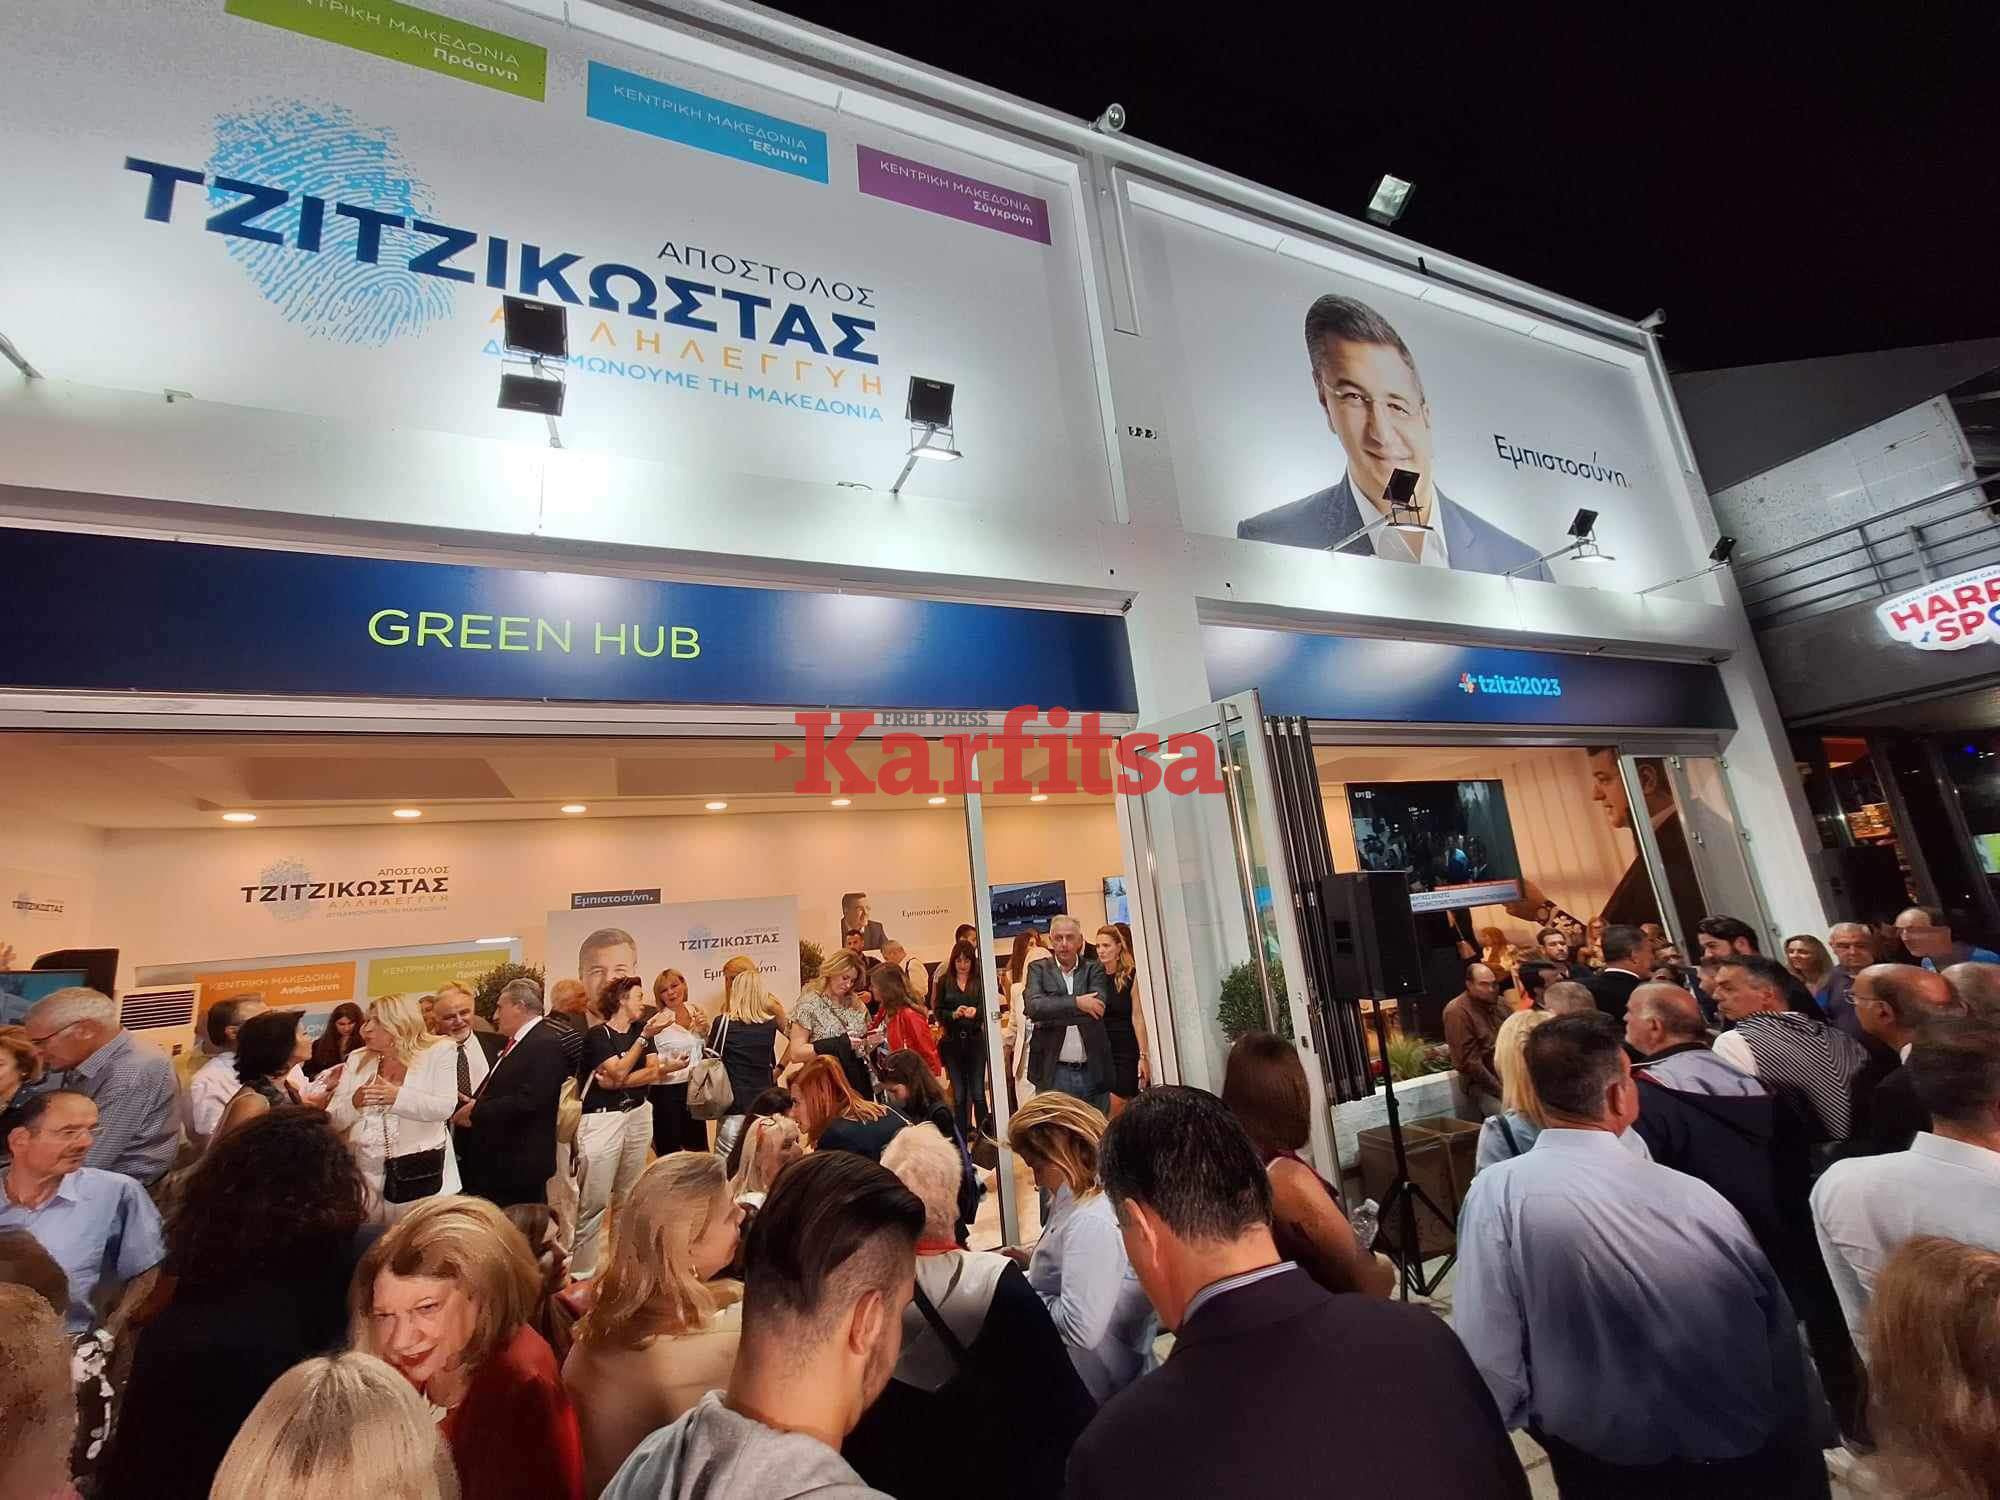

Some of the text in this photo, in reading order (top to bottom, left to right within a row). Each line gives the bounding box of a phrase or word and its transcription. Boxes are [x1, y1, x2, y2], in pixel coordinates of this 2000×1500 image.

[389, 17, 520, 67] ΜΑΚΕΔΟΝΙΑ
[433, 48, 519, 82] Πράσινη
[613, 84, 808, 151] ΚΕΝΤΡΙΚΗ ΜΑΚΕΔΟΝΙΑ
[880, 160, 1032, 213] ΚΕΝΤΡΙΚΗ ΜΑΚΕΔΟΝΙΑ
[974, 200, 1033, 226] Σύγχρονη
[124, 156, 880, 365] ΤΖΙΤΖΙΚΩΣΤΑΣ
[657, 241, 877, 309] ΑΠΟΣΤΟΛΟΣ
[489, 306, 882, 396] ΑΛΗΛΕΓΓΥΗ
[481, 338, 883, 422] ΔΜΩΝΟΥΜΕ ΤΗ ΜΑΚΕΔΟΝΙΑ
[367, 608, 702, 660] GREEN HUB
[1477, 674, 1562, 697] tzitzi2023
[240, 877, 449, 903] ΤΖΙΤΖΙΚΩΣΤΑΣ
[377, 866, 449, 877] ΑΠΟΣΤΟΛΟΣ
[680, 933, 780, 951] ΤΖΙΤΖΙΚΩΣΤΑΣ
